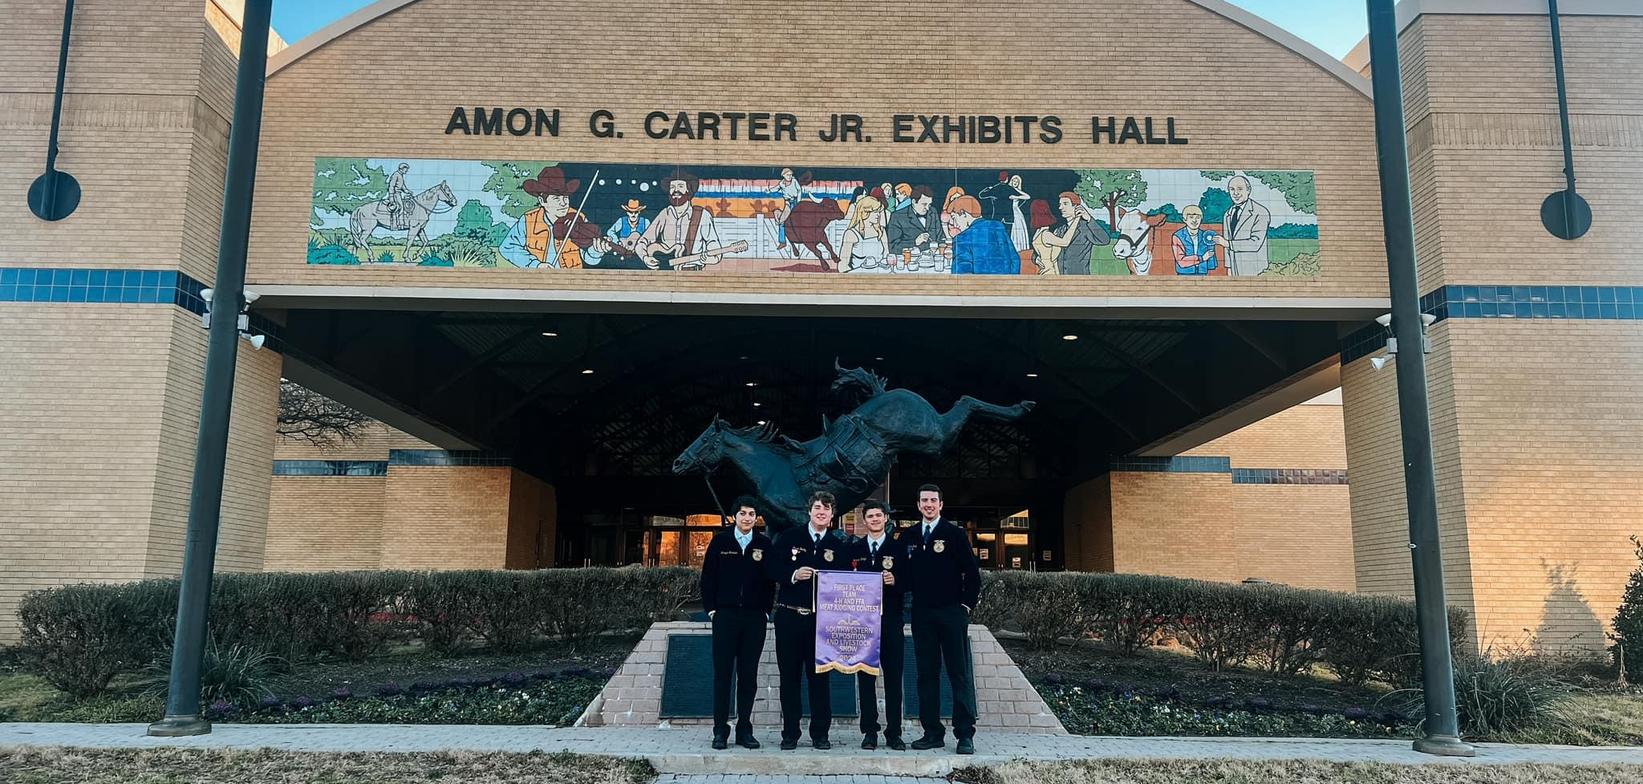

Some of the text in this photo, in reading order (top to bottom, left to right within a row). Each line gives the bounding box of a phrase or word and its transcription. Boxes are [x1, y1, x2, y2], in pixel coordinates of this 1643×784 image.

[445, 107, 1189, 145] AMON G. CARTER JR. EXHIBITS HALL
[849, 584, 866, 592] PLACE
[819, 603, 834, 611] MEAT
[840, 639, 872, 647] LIVESTOCK
